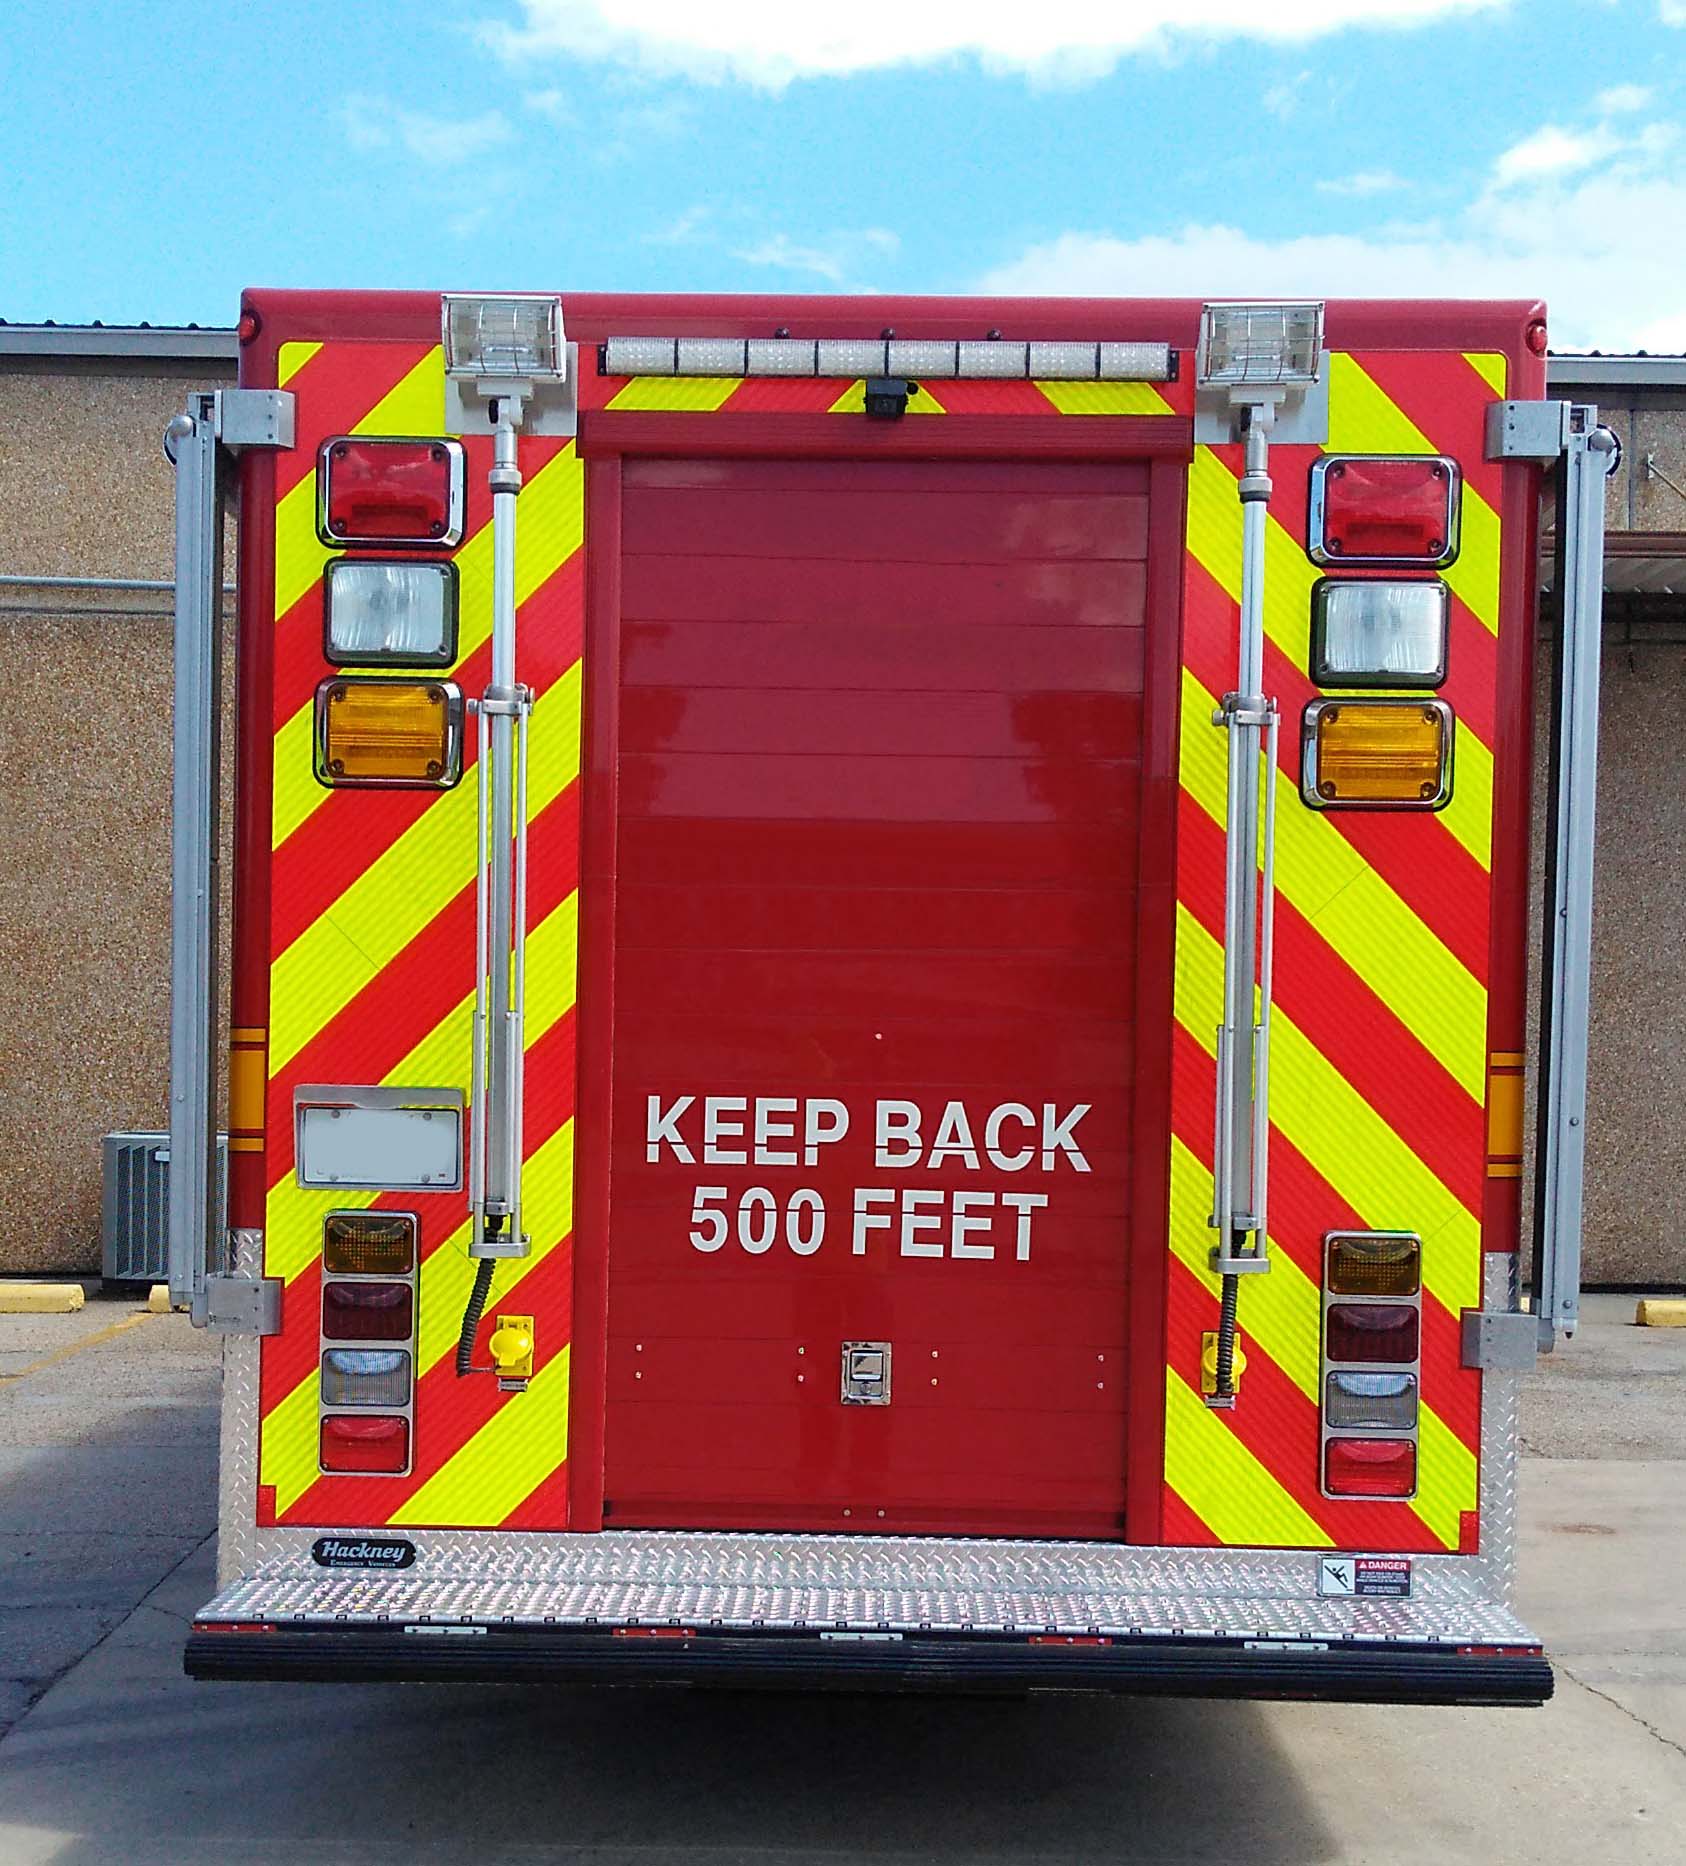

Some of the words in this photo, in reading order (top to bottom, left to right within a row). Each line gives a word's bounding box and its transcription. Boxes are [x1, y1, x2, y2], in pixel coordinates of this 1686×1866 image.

[646, 1095, 850, 1166] KEEP
[875, 1100, 1092, 1172] BACK
[689, 1186, 826, 1256] 500
[852, 1188, 1049, 1261] FEET
[321, 1541, 406, 1562] Hackney
[1368, 1561, 1407, 1570] DANGER
